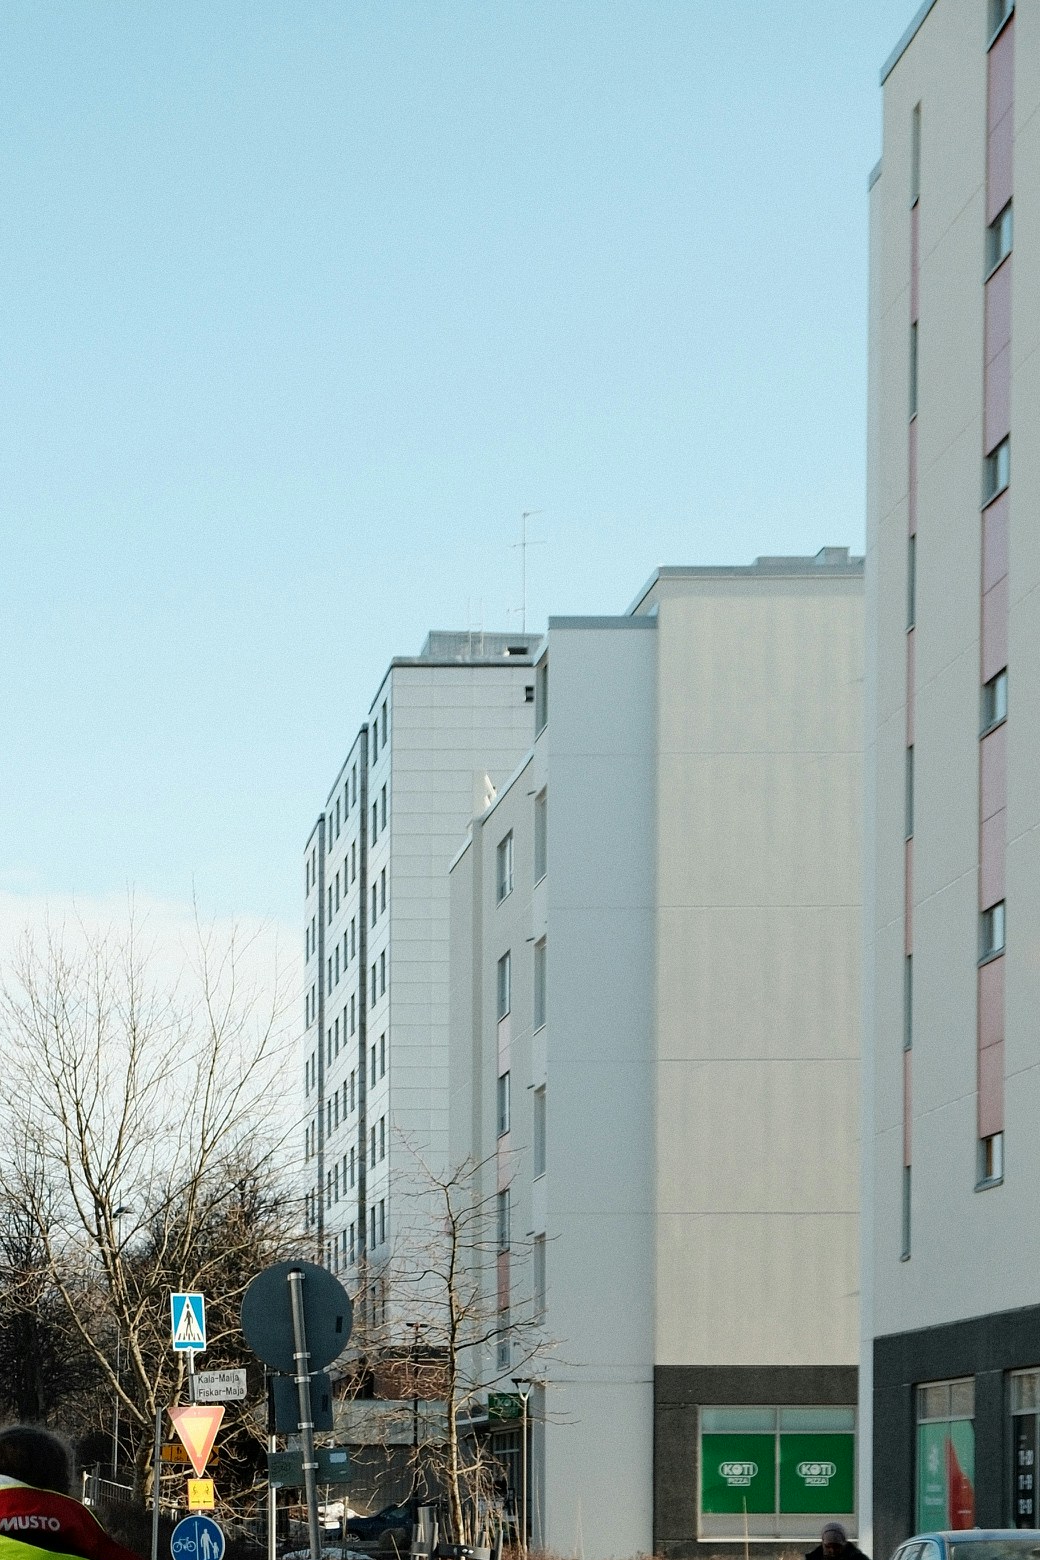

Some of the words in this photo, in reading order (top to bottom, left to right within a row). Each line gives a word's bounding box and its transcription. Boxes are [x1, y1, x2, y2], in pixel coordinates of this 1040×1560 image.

[198, 1373, 240, 1384] Kala-Maija
[198, 1386, 244, 1397] Fiskar-Maja
[723, 1464, 754, 1475] KOTI
[801, 1464, 832, 1475] KOTI
